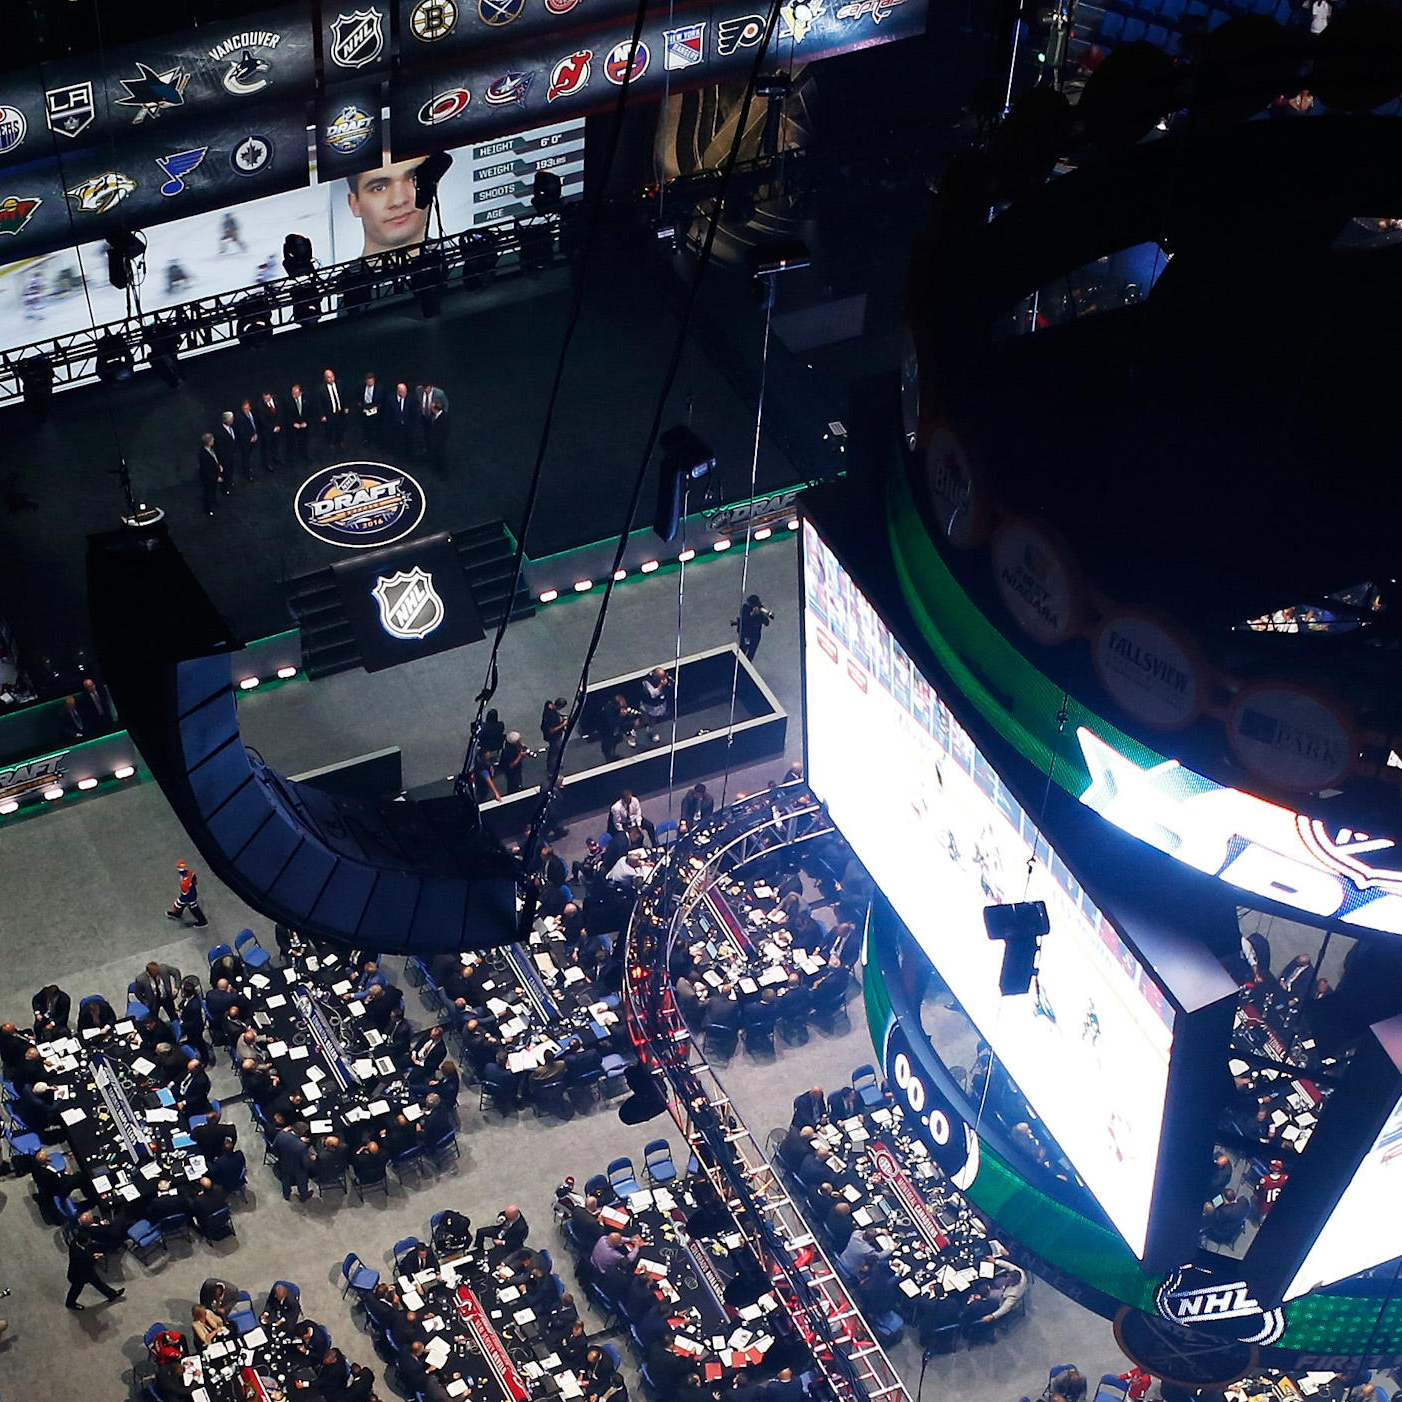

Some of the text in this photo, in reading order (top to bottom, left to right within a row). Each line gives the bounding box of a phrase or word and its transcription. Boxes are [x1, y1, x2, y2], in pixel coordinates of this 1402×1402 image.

[209, 31, 281, 61] VANCOUVER
[343, 19, 374, 59] NHL
[50, 89, 88, 112] LA
[326, 116, 374, 137] DRAFT
[480, 141, 513, 156] HEIGHT
[479, 163, 515, 178] WEIGHT
[479, 184, 515, 201] SHOOTS
[486, 209, 504, 220] AGE
[312, 478, 402, 516] DRAFT
[731, 491, 797, 521] DRAF
[362, 519, 384, 529] 2016
[397, 585, 426, 626] NHL
[1107, 630, 1189, 695] FALLSVIEW
[913, 1203, 939, 1238] CANADIENS
[1177, 1285, 1259, 1319] NHL
